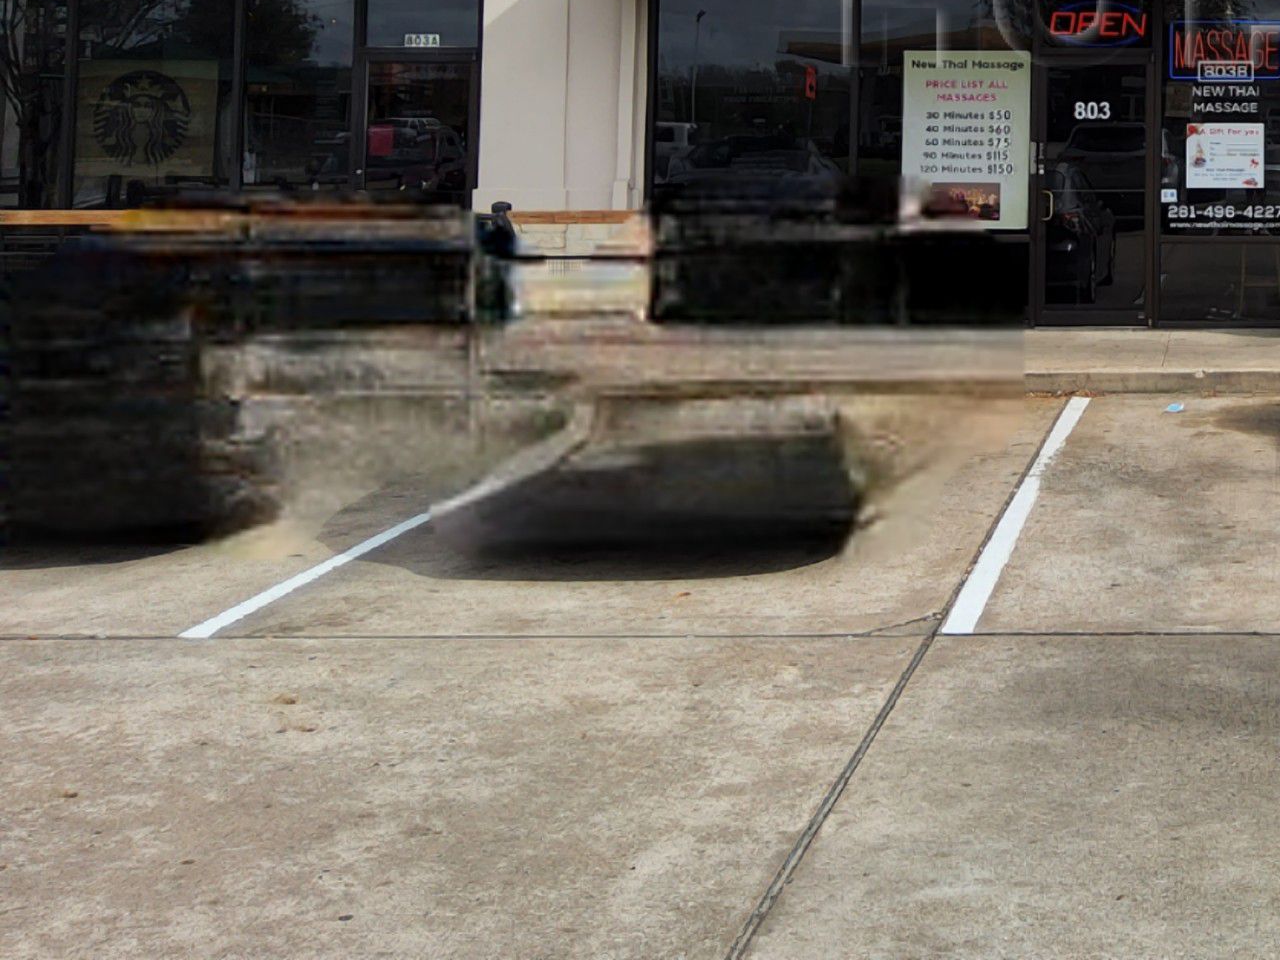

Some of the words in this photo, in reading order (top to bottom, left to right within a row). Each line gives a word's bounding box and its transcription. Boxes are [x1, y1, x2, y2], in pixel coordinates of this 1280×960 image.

[1048, 10, 1148, 39] OPEN
[1173, 29, 1280, 71] MASSAGE
[911, 60, 937, 69] New
[942, 59, 968, 69] Thai
[972, 60, 1025, 71] Massage
[1203, 64, 1249, 79] 803B
[925, 80, 958, 89] PRICE
[961, 80, 984, 89] LIST
[988, 80, 1008, 89] ALL
[1192, 85, 1225, 98] NEW
[1228, 85, 1260, 98] THAI
[937, 93, 997, 102] MASSAGES
[1074, 101, 1111, 120] 803
[1193, 102, 1259, 114] MASSAGE
[926, 111, 940, 120] 30
[943, 110, 985, 120] Minutes
[988, 110, 1011, 120] $50
[925, 125, 939, 133] 40
[943, 124, 985, 133] Minutes
[988, 125, 1011, 135] $60
[925, 138, 939, 146] 60
[942, 137, 984, 146] Minutes
[987, 138, 1011, 148] $75
[922, 152, 937, 160] 90
[941, 151, 982, 160] Minutes
[986, 151, 1009, 161] $115
[920, 164, 938, 173] 120
[941, 164, 983, 173] Minutes
[987, 163, 1013, 174] $150
